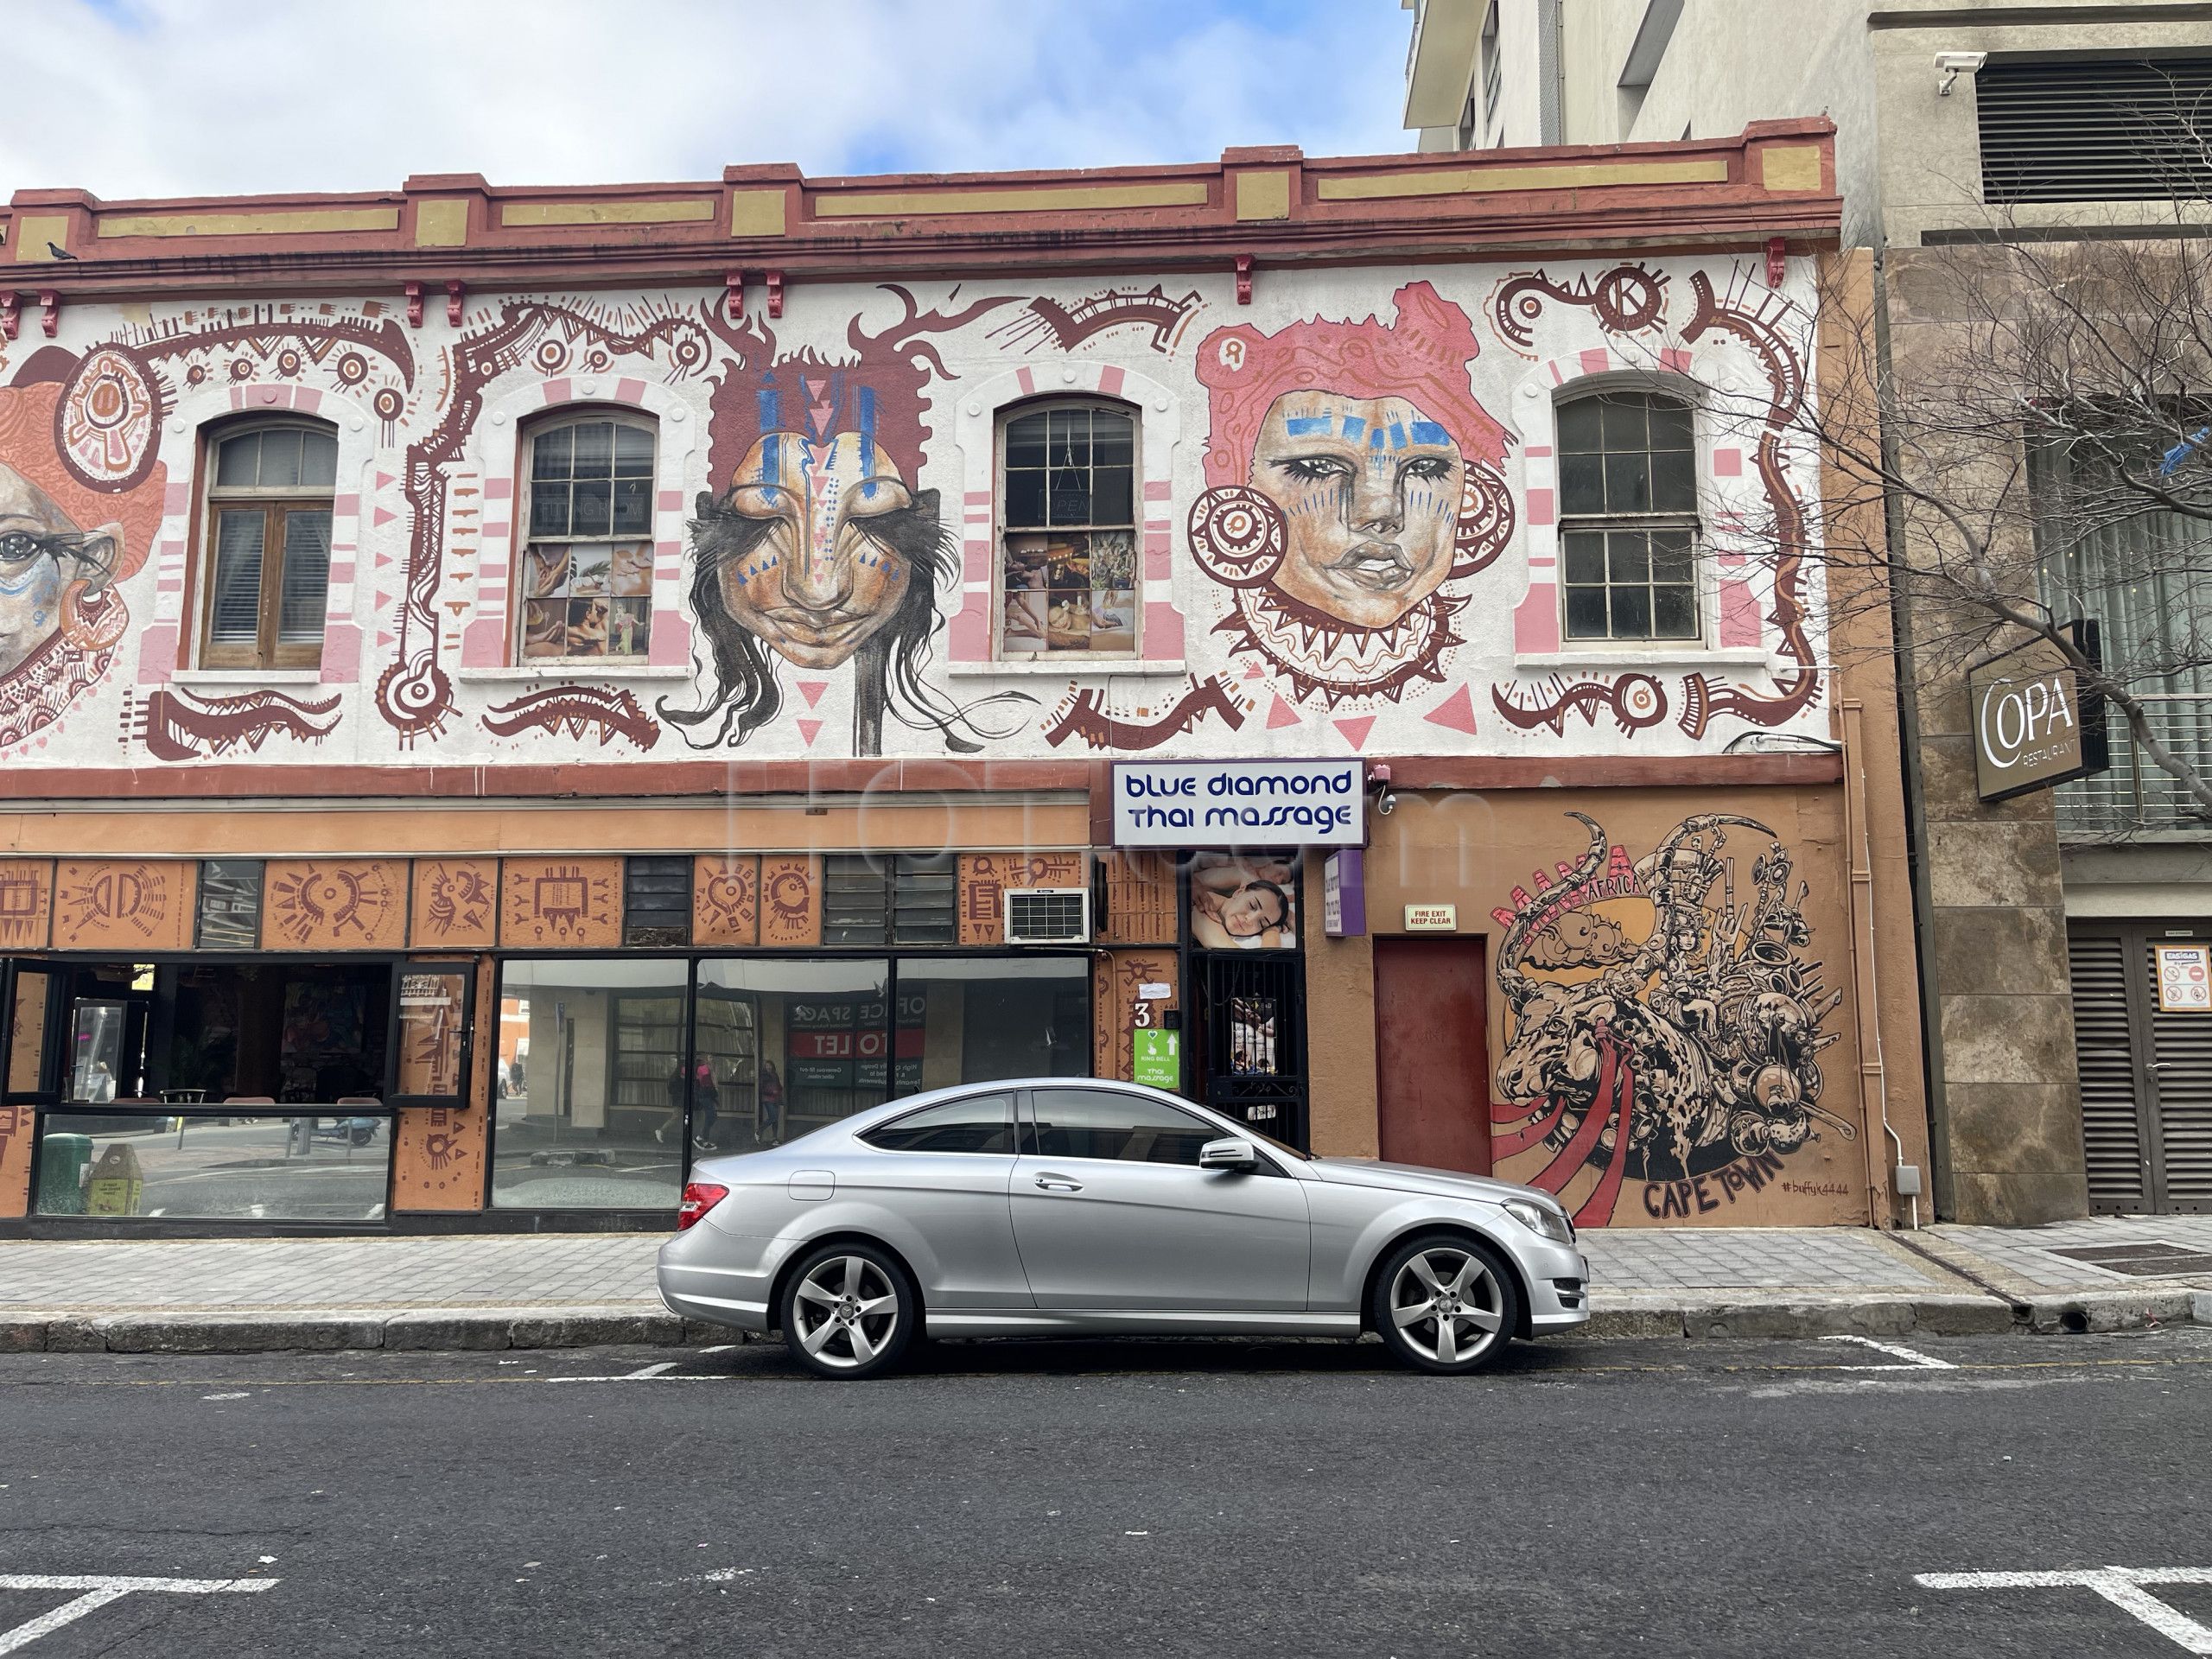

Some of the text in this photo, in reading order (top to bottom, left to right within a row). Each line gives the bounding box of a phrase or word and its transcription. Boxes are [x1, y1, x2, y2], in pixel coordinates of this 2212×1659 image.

[1981, 674, 2074, 768] COPA
[2022, 739, 2075, 768] RESTAURANT
[1207, 769, 1351, 797] diamond
[1205, 804, 1351, 835] massage
[1587, 874, 1641, 900] AFRICA
[1134, 1002, 1151, 1027] 3
[1137, 1075, 1173, 1084] massage
[1643, 1151, 1785, 1219] CAPE TOWN
